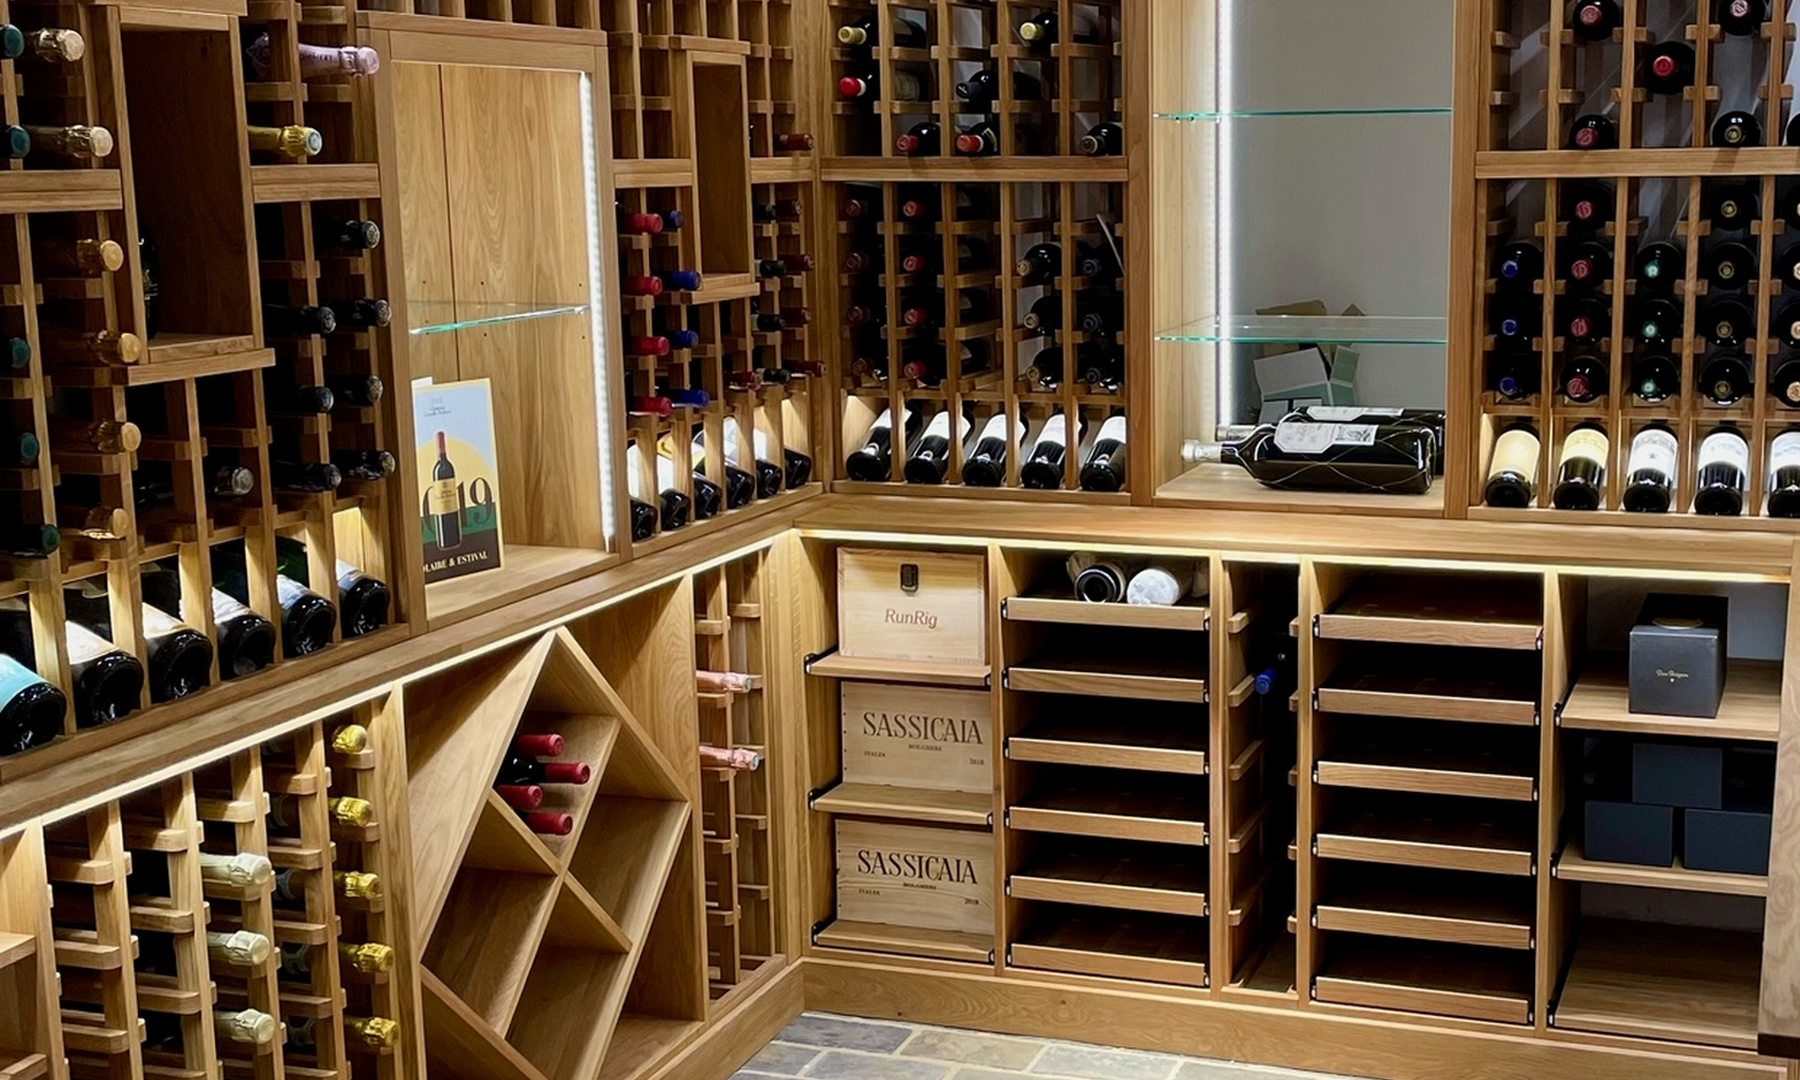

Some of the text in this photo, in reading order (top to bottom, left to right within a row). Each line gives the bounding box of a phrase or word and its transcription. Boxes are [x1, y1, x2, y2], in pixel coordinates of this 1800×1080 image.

[449, 557, 456, 567] &
[457, 550, 488, 564] ESTIVAL
[885, 608, 938, 629] RunRig
[863, 711, 984, 745] SASSICAIA
[857, 849, 979, 885] SASSICAIA
